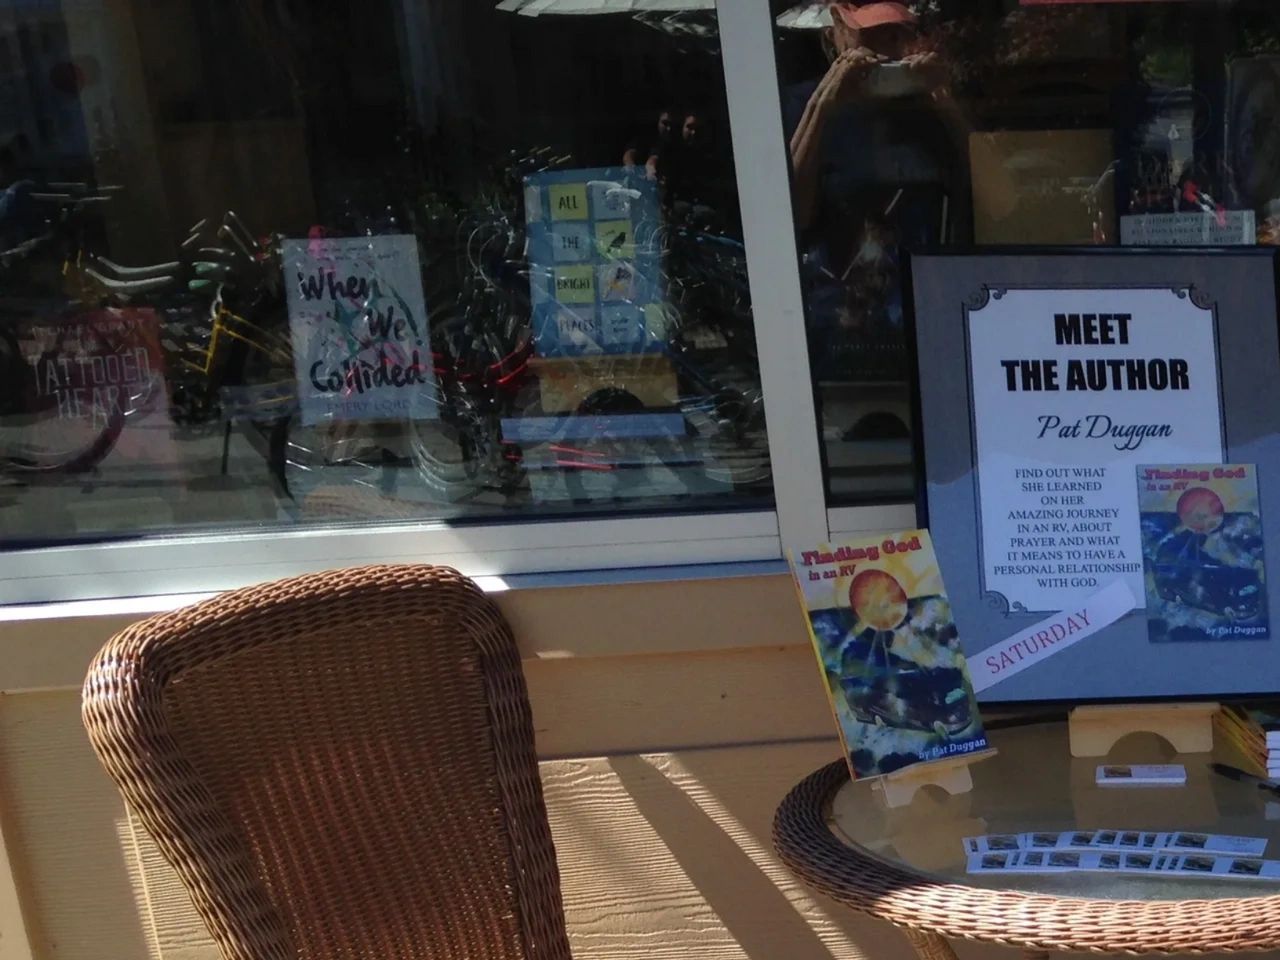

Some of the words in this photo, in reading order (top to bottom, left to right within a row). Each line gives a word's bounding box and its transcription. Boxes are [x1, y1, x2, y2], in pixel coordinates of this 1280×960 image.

[558, 195, 580, 211] ALL
[561, 235, 581, 250] THE
[298, 266, 383, 301] When
[557, 278, 591, 291] BRIGHT
[365, 304, 407, 342] We
[1054, 313, 1132, 345] MEET
[309, 350, 427, 394] Collided
[1001, 360, 1060, 391] THE
[1066, 358, 1190, 391] AUTHOR
[1037, 415, 1082, 439] Pat
[1085, 414, 1173, 451] Duggan
[1015, 468, 1043, 479] FIND
[1045, 468, 1070, 478] OUT
[1072, 467, 1106, 478] WHAT
[1212, 467, 1246, 479] God
[1021, 482, 1044, 492] SHE
[1047, 481, 1102, 492] LEARNED
[1040, 495, 1058, 506] ON
[1061, 495, 1085, 505] HER
[1007, 509, 1064, 520] AMAZING
[1066, 508, 1119, 519] JOURNEY
[1017, 523, 1030, 533] IN
[1032, 523, 1049, 533] AN
[1052, 522, 1069, 534] RV,
[1072, 522, 1112, 533] ABOUT
[1010, 537, 1056, 548] PRAYER
[1058, 536, 1084, 547] AND
[1087, 536, 1120, 546] WHAT
[801, 546, 881, 566] Finding
[881, 536, 923, 554] God
[1007, 551, 1018, 561] IT
[1021, 550, 1063, 561] MEANS
[1065, 550, 1081, 560] TO
[1084, 549, 1115, 560] HAVE
[1116, 549, 1126, 559] A
[808, 569, 821, 582] in
[822, 568, 838, 579] an
[839, 564, 856, 578] RV
[993, 564, 1055, 576] PERSONAL
[1057, 562, 1141, 574] RELATIONSHIP
[1036, 577, 1067, 588] WITH
[1206, 626, 1217, 637] by
[1218, 625, 1232, 635] Pat
[1233, 625, 1267, 636] Duggan
[985, 608, 1091, 674] SATURDAY
[918, 749, 930, 760] by
[932, 745, 948, 757] Pat
[949, 738, 987, 753] Duggan
